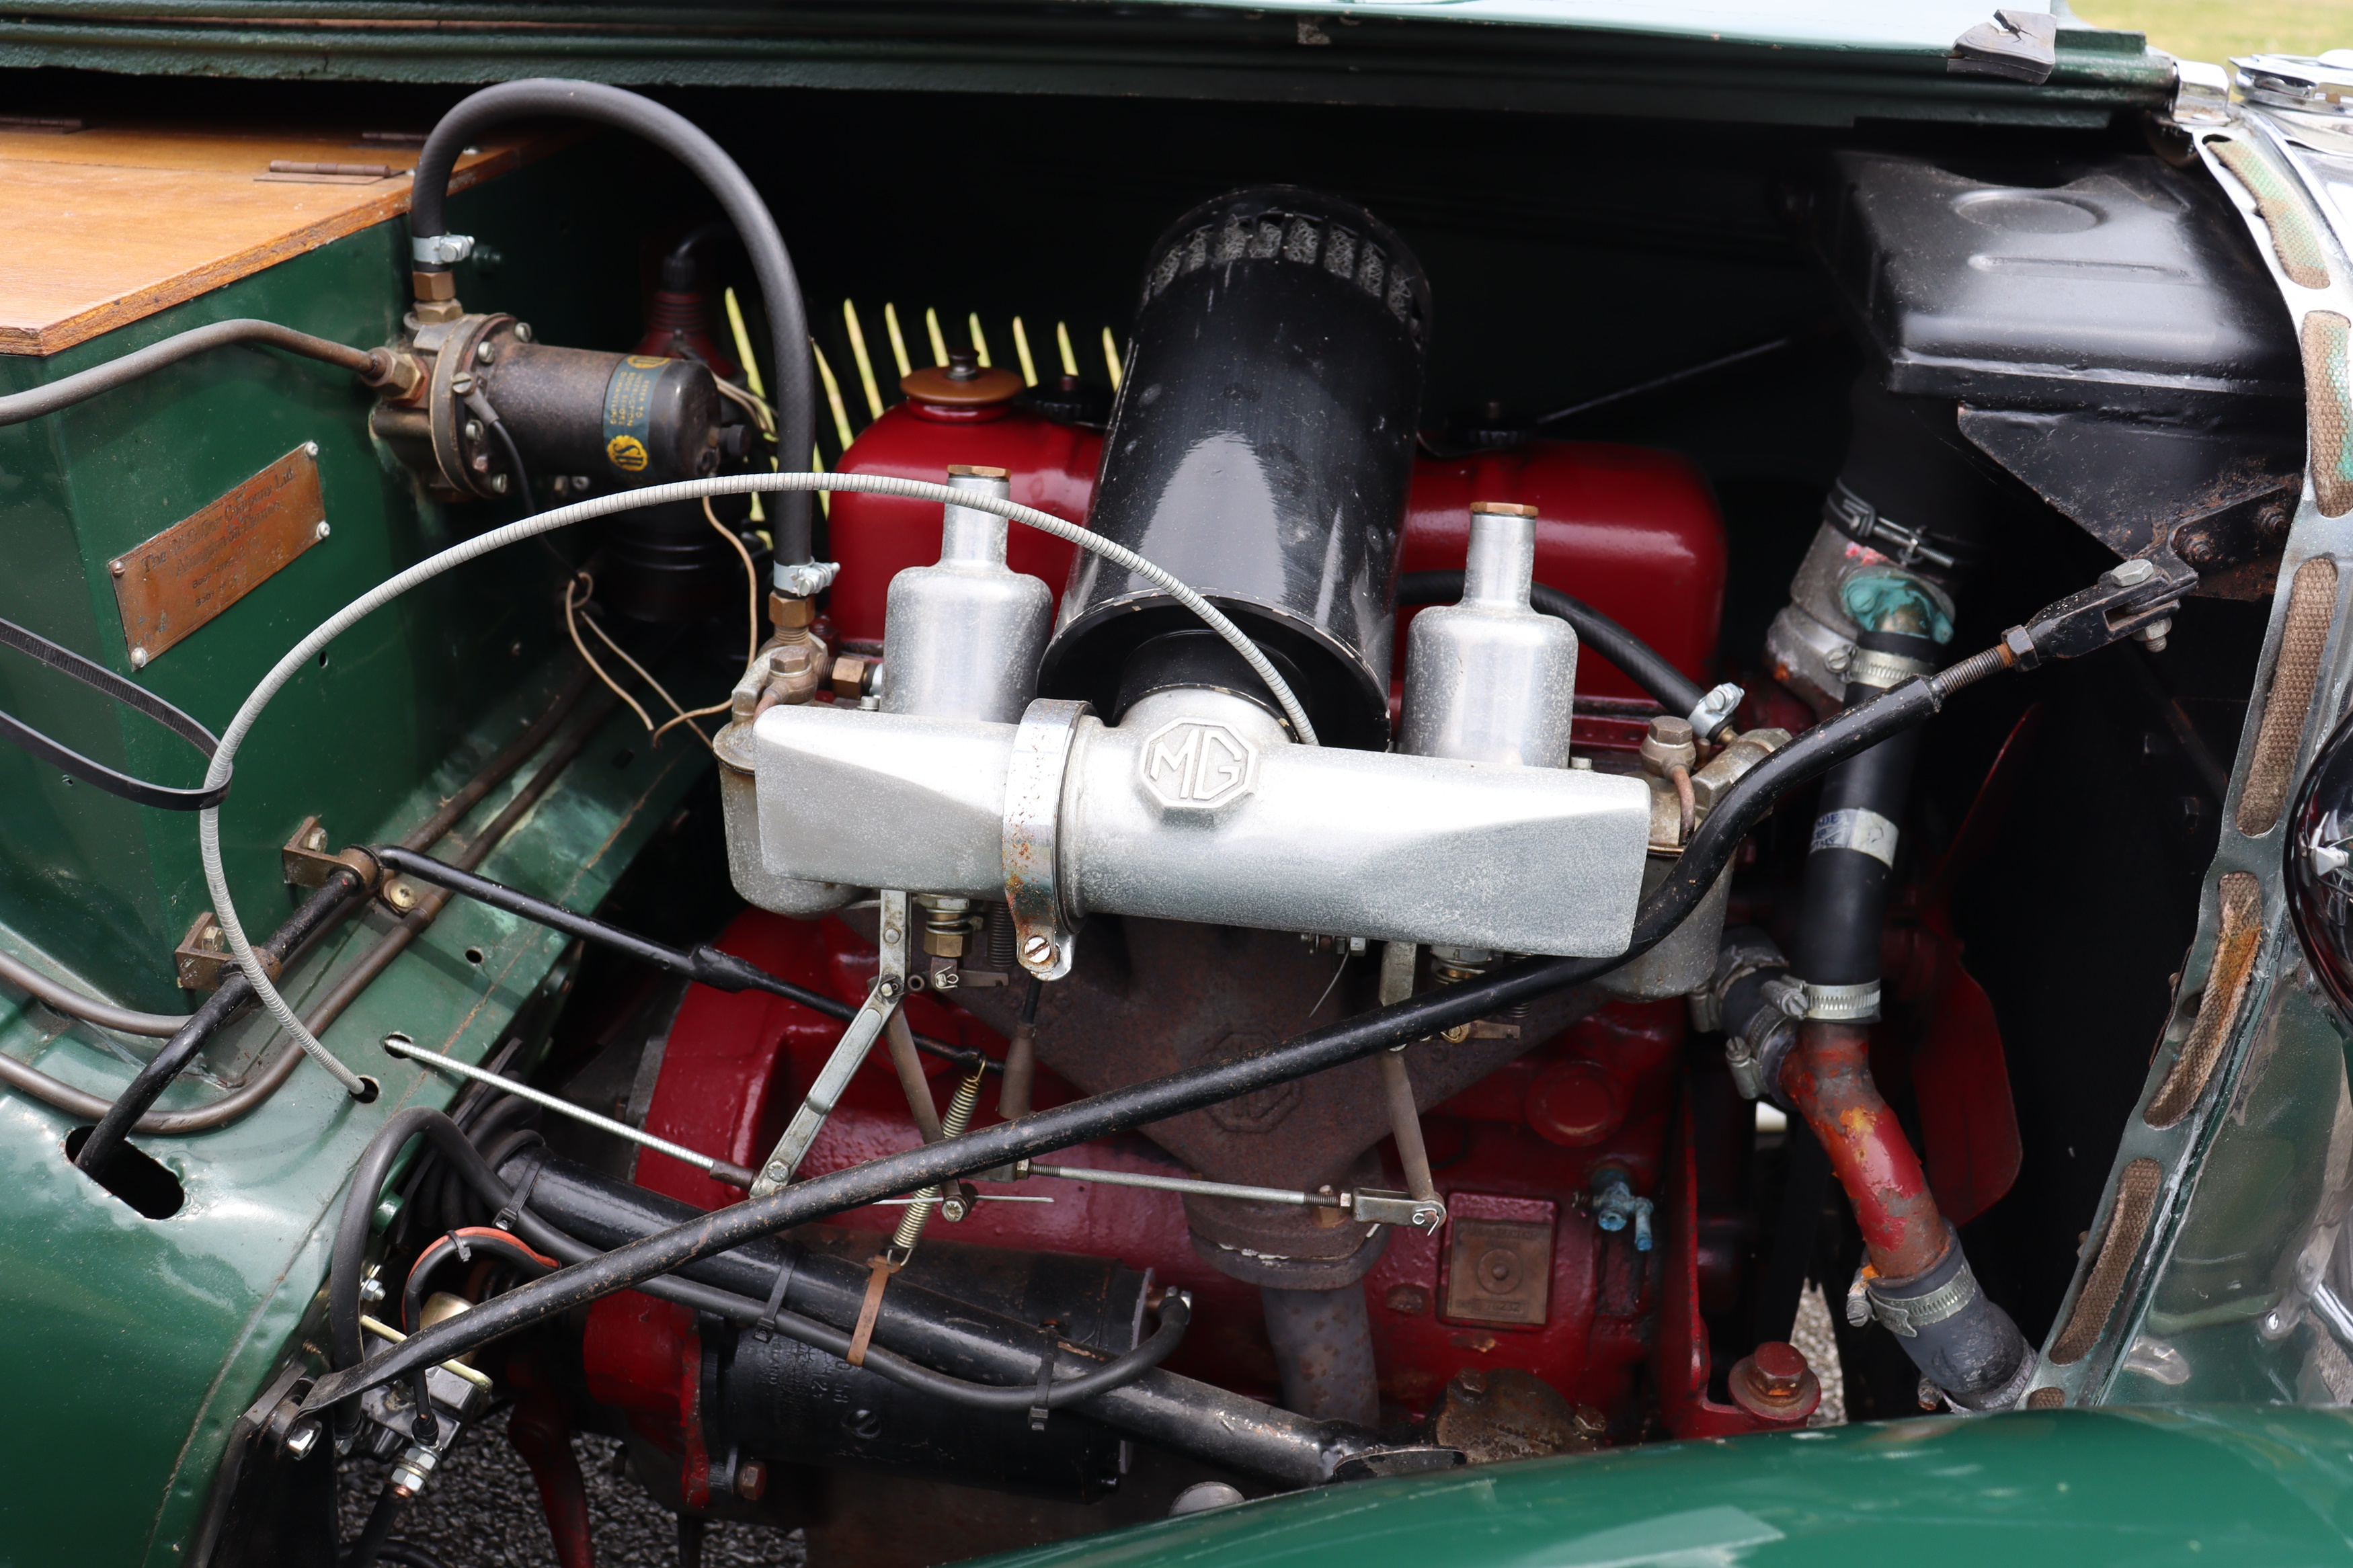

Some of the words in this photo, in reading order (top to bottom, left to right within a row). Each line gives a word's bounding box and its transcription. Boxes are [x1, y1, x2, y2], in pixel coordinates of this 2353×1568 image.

[624, 372, 637, 391] BOOK
[618, 395, 628, 425] BEFORE
[635, 406, 645, 419] TO
[141, 551, 167, 575] The
[1150, 729, 1242, 800] MG
